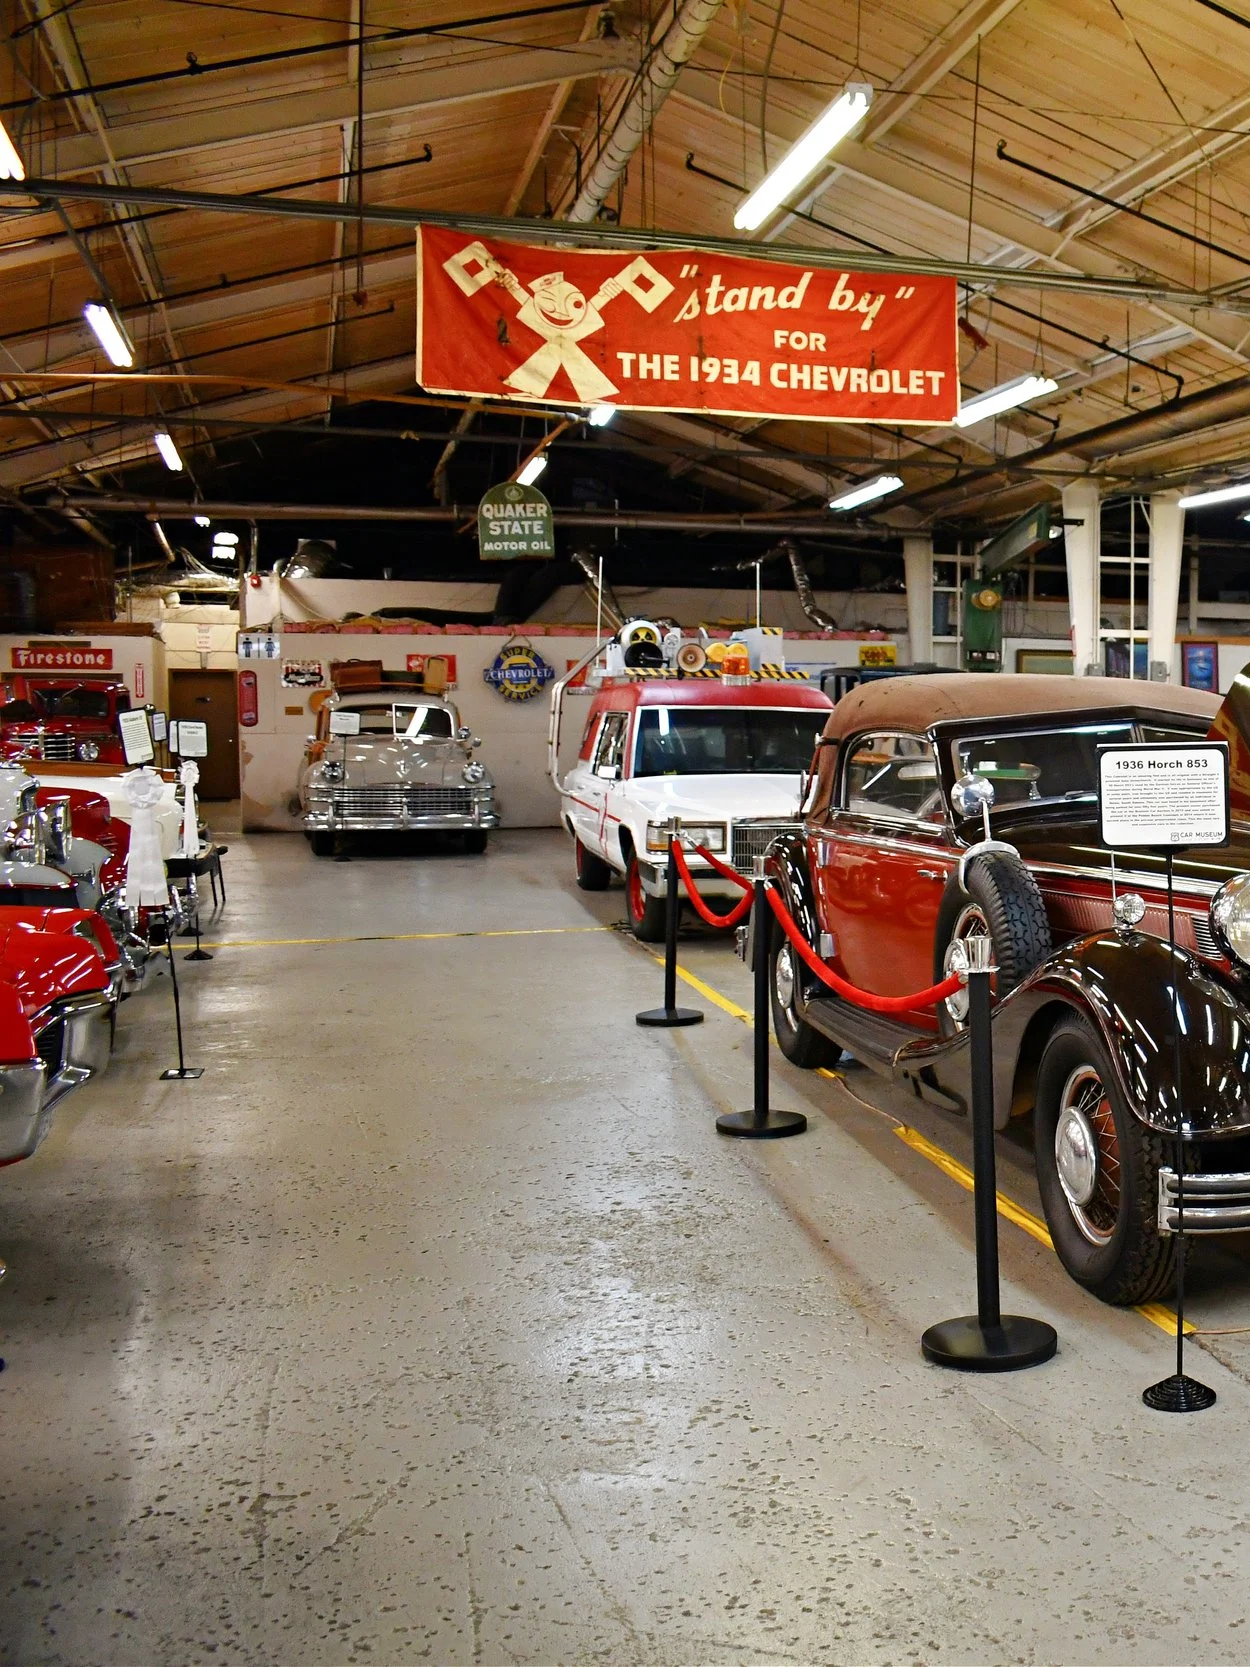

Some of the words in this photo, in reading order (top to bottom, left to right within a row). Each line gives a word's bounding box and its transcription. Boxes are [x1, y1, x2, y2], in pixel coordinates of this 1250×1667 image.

[673, 265, 813, 322] "stand
[828, 273, 915, 331] by"
[773, 329, 826, 352] FOR
[617, 352, 679, 381] THE
[690, 356, 760, 386] 1934
[769, 362, 945, 396] CHEVROLET
[482, 503, 548, 519] QUAKER
[489, 521, 544, 535] STATE
[484, 541, 527, 551] MOTOR
[531, 540, 552, 550] OIL
[17, 649, 106, 667] Firestone
[500, 647, 536, 660] SUPER
[490, 668, 549, 680] CHEVROLET
[1116, 760, 1144, 770] 1936
[1148, 759, 1183, 769] Horch
[1187, 759, 1208, 768] 853
